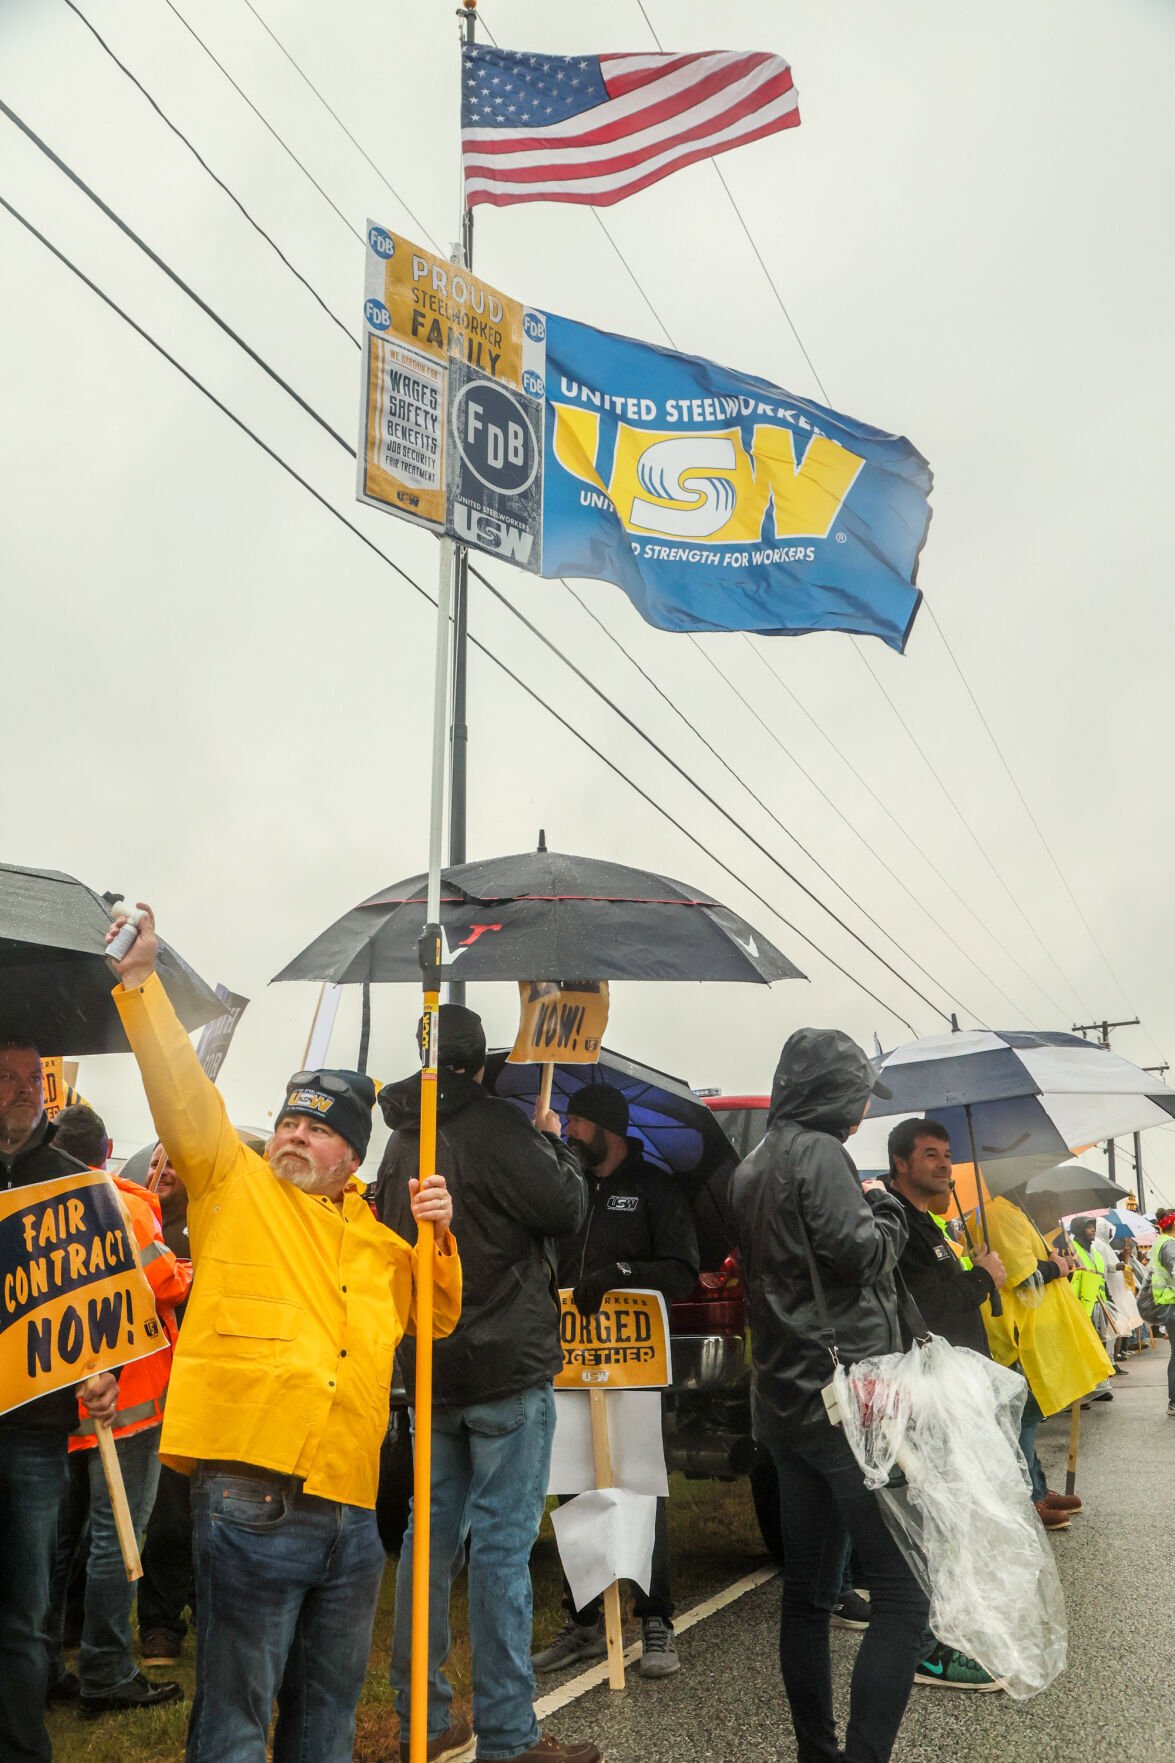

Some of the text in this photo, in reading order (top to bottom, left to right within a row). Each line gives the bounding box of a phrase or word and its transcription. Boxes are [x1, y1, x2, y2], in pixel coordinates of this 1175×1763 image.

[370, 231, 394, 255] FDB
[411, 254, 504, 324] PROUD
[366, 303, 391, 327] FDB
[412, 287, 502, 349] STEELWORKER
[525, 317, 546, 338] FDB
[390, 369, 438, 411] WAGES
[524, 373, 545, 395] FDB
[560, 376, 657, 422] UNITED
[389, 395, 438, 433] SAFETY
[387, 420, 438, 455] BENEFITS
[467, 400, 525, 469] FDB
[385, 455, 435, 483] FAIR TREATMENT
[386, 440, 436, 470] JOB SECURITY
[550, 401, 867, 545] USW
[457, 494, 530, 532] UNITED STEELWORKERS
[454, 501, 534, 564] USW
[643, 544, 720, 566] STRENGTH
[722, 545, 749, 568] FOR
[751, 547, 815, 566] WORKERS
[288, 1092, 334, 1113] USW
[607, 1196, 639, 1211] USW
[22, 1198, 87, 1253] FAIR
[4, 1229, 125, 1313] CONTRACT
[27, 1288, 134, 1378] NOW!
[561, 1310, 652, 1344] ORGED
